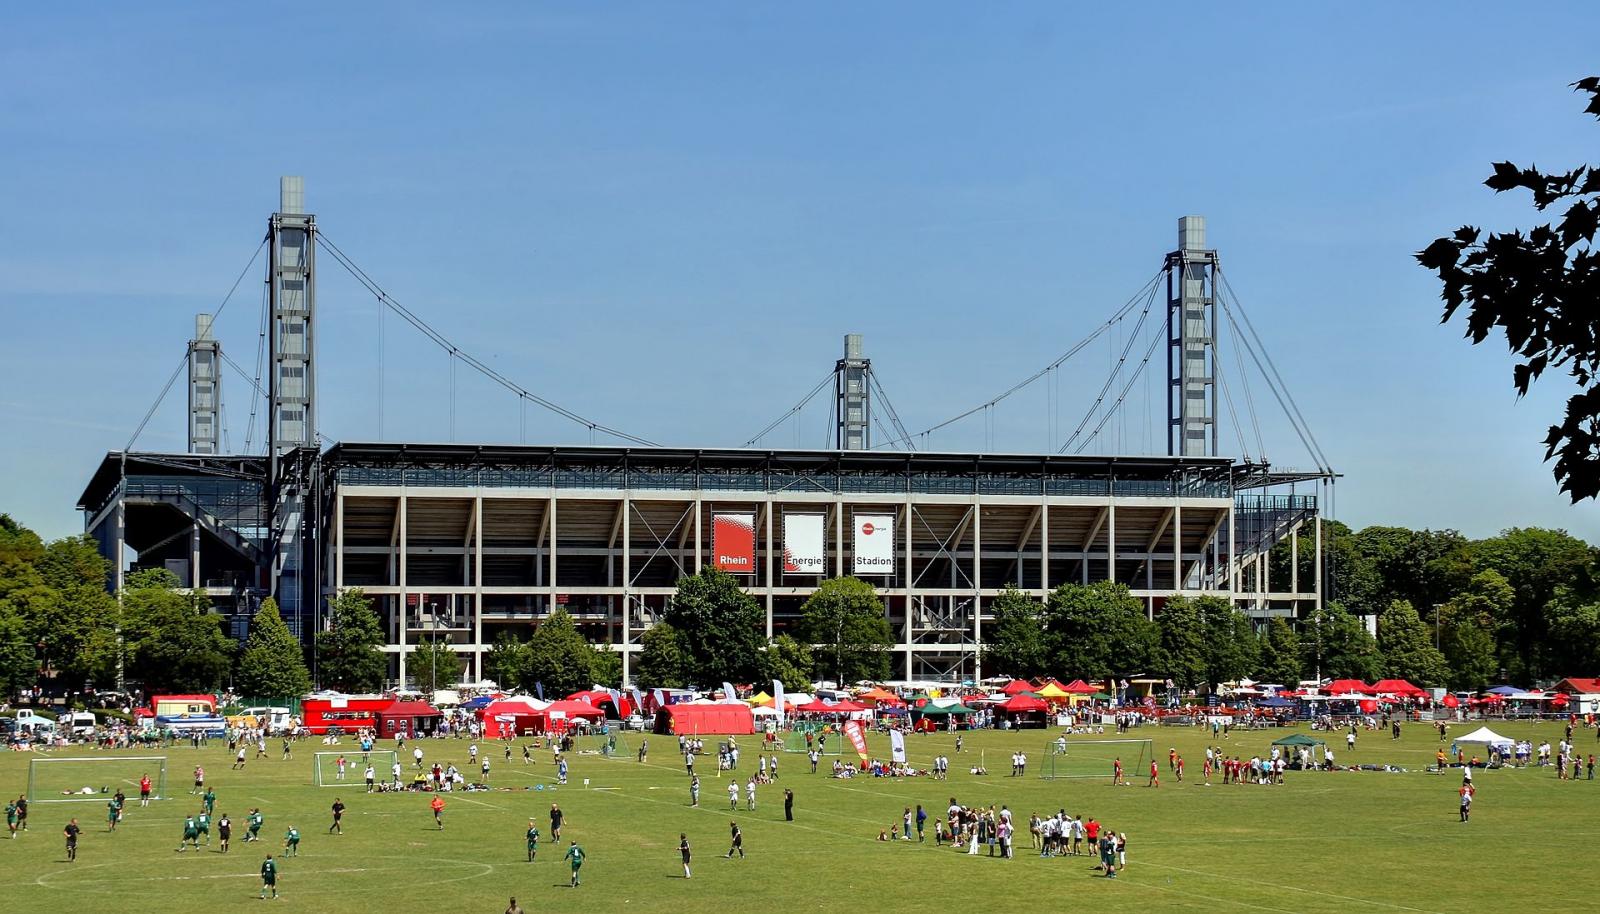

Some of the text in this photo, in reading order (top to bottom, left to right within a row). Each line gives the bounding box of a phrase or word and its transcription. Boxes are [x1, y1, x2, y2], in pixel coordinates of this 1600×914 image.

[720, 556, 892, 567] Rhein Energie Stadion
